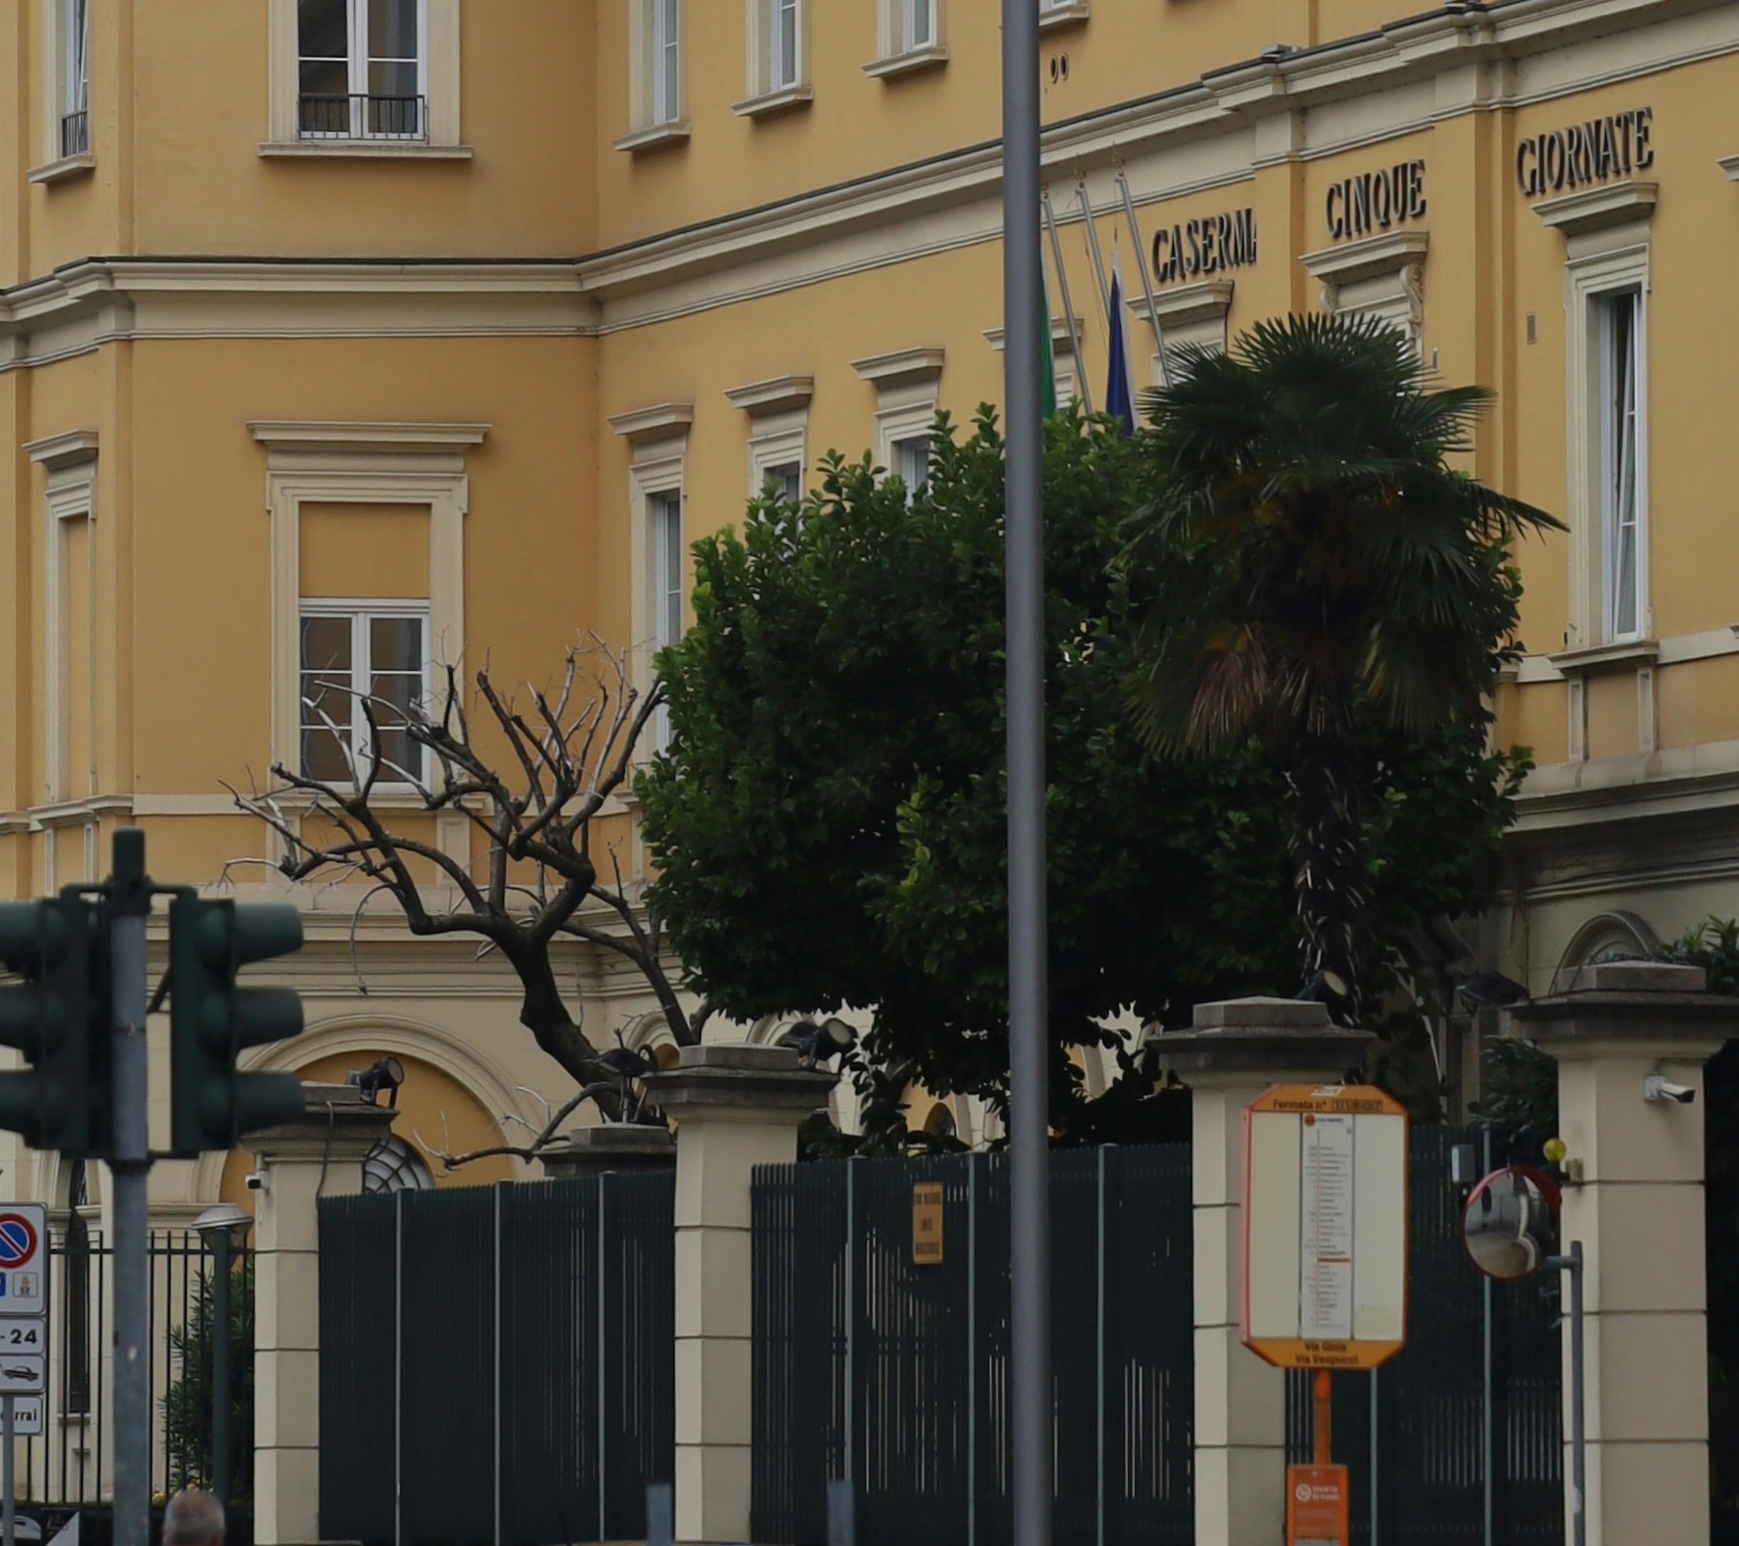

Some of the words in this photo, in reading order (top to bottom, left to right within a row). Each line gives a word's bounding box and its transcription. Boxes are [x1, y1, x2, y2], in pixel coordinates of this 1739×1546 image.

[1325, 159, 1427, 239] CINQUE
[1517, 106, 1655, 196] GIORNATE
[10, 1329, 38, 1345] 24
